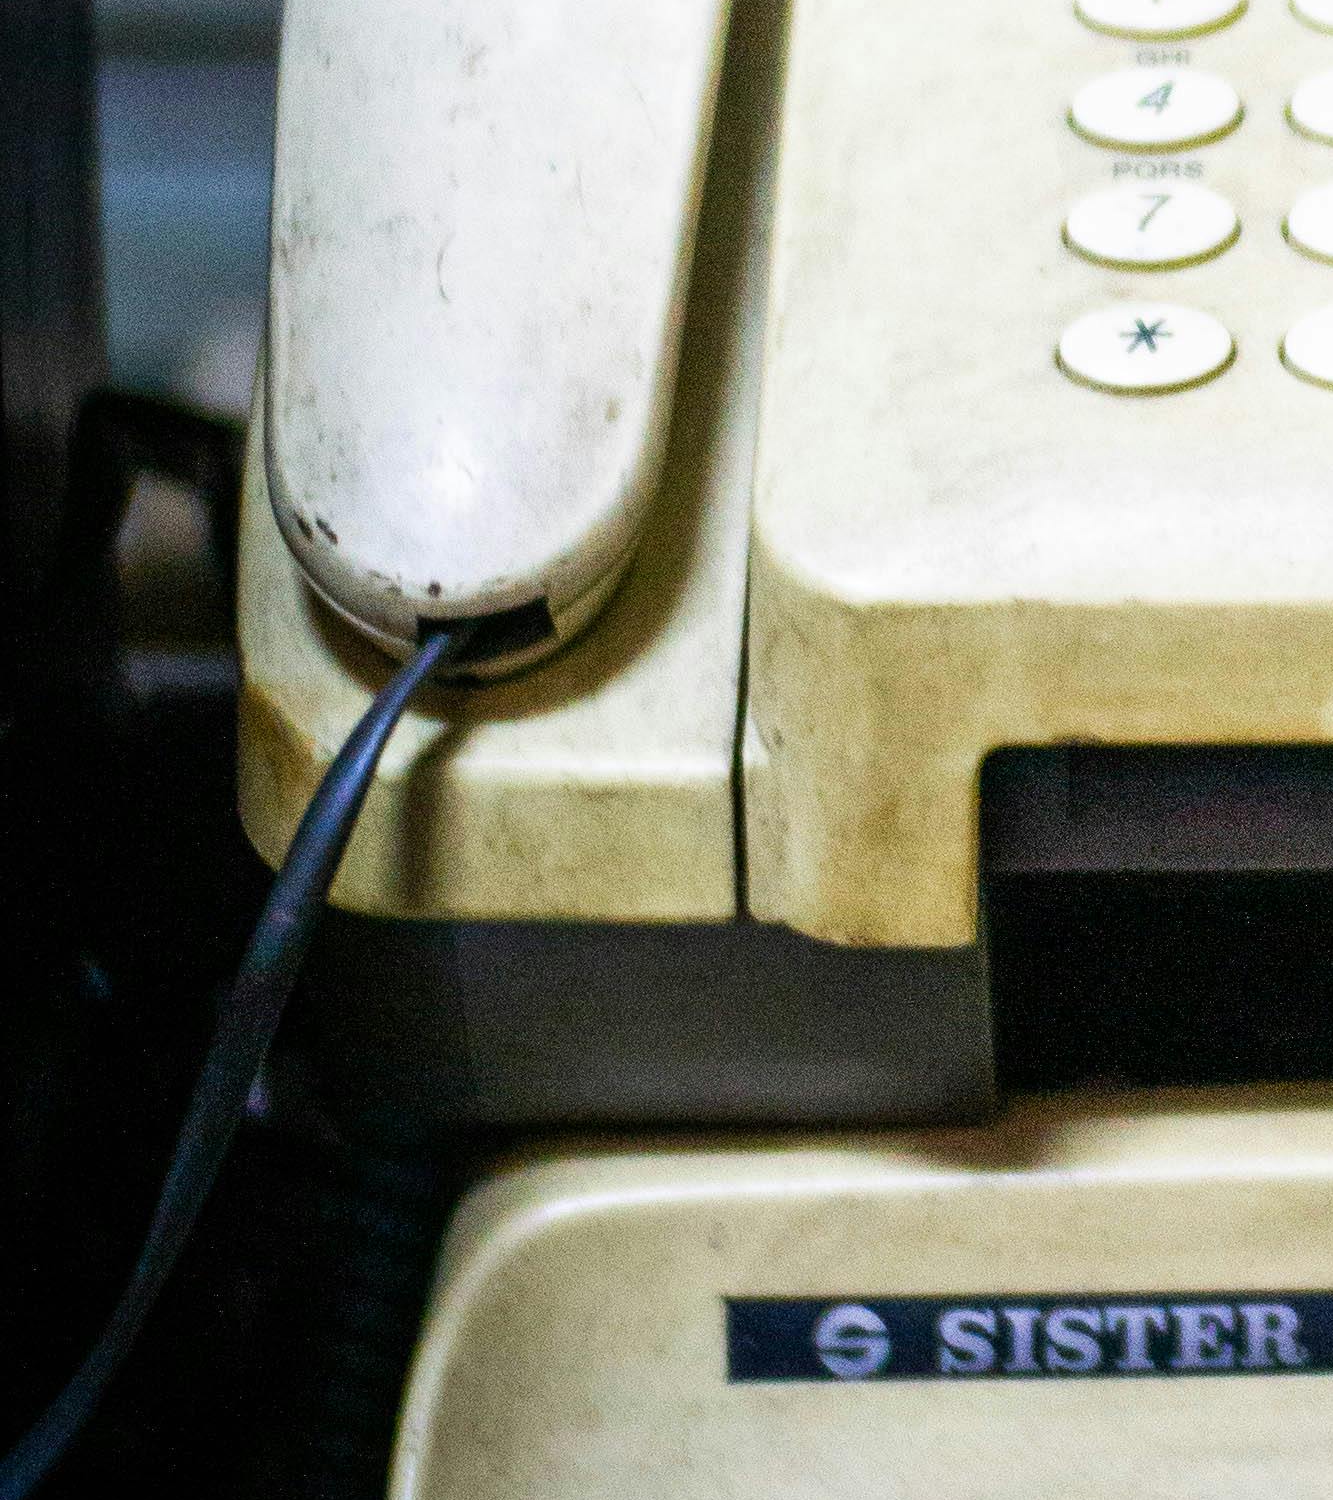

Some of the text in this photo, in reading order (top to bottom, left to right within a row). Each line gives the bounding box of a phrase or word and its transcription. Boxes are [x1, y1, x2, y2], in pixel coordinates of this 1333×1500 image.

[1136, 80, 1176, 114] 4
[1134, 193, 1172, 232] 7
[938, 1304, 1308, 1373] SISTER
